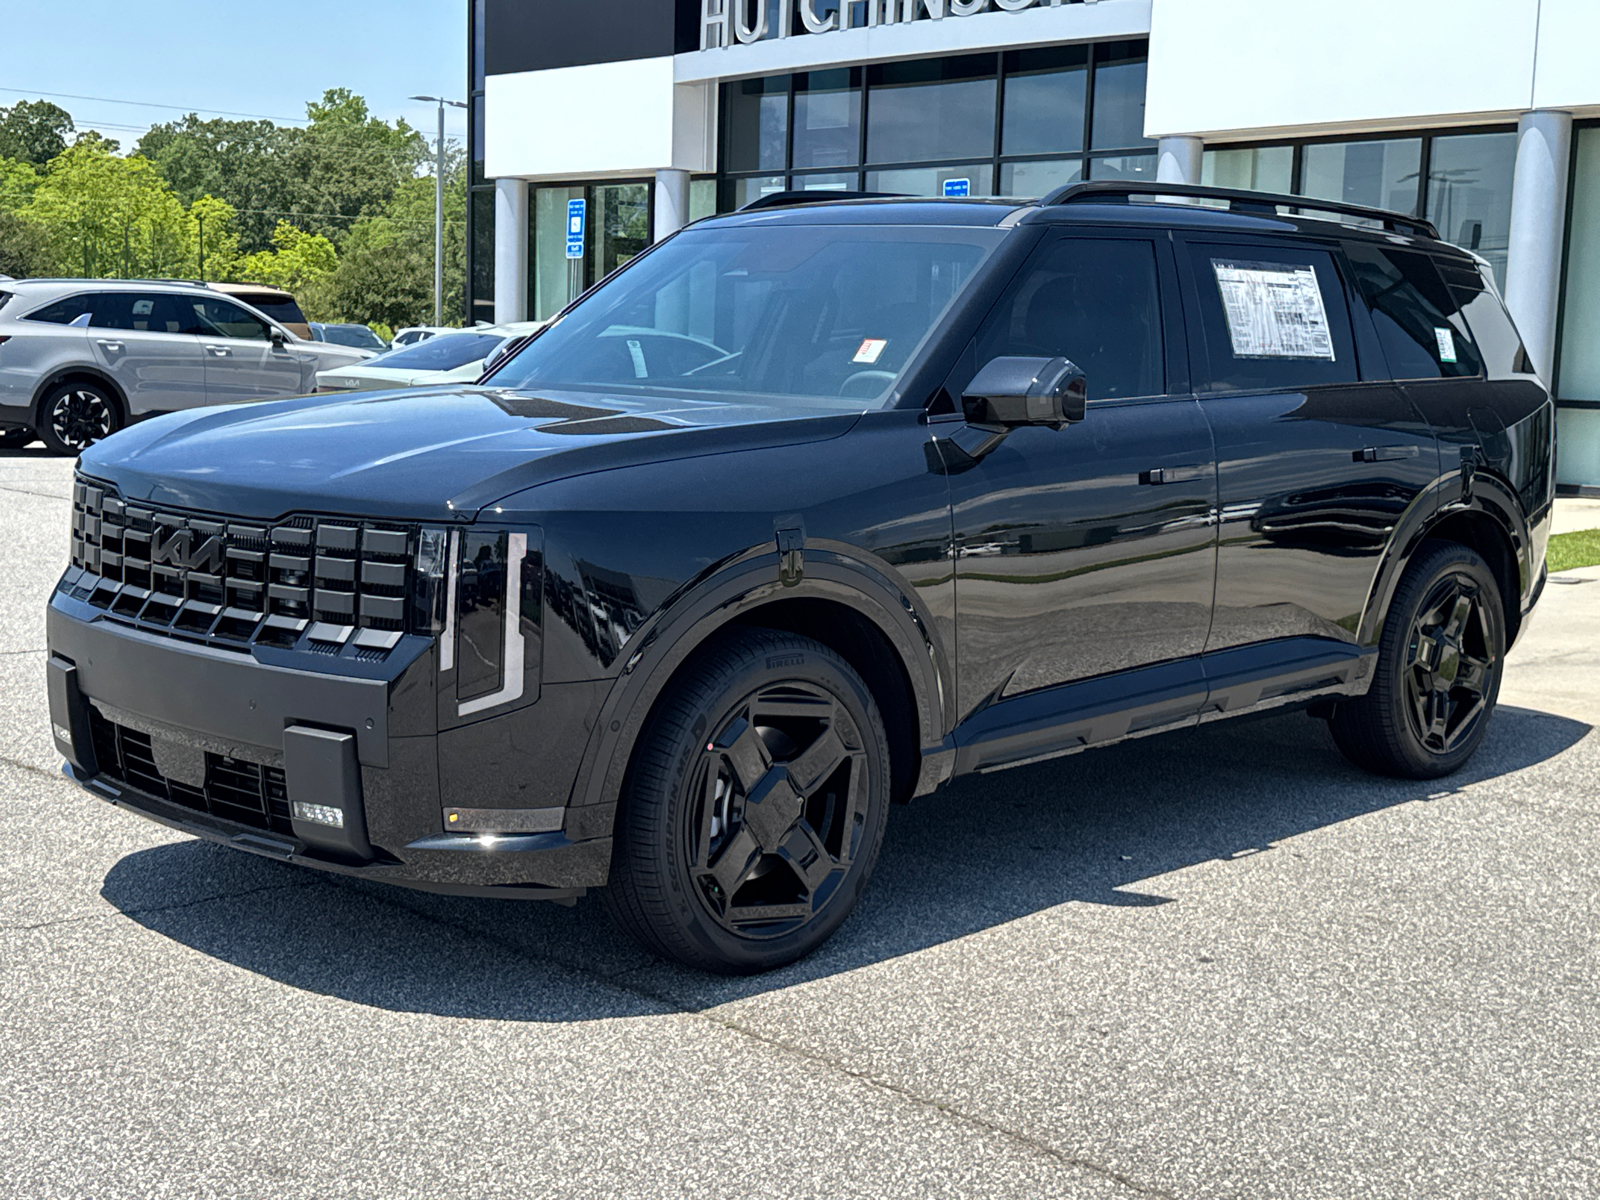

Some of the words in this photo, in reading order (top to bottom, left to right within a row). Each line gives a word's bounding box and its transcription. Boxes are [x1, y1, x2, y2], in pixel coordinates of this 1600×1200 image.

[699, 0, 1099, 52] HUTCH
[152, 525, 223, 573] KIA
[765, 652, 805, 670] PIRELLI
[666, 782, 681, 893] SCORPION
